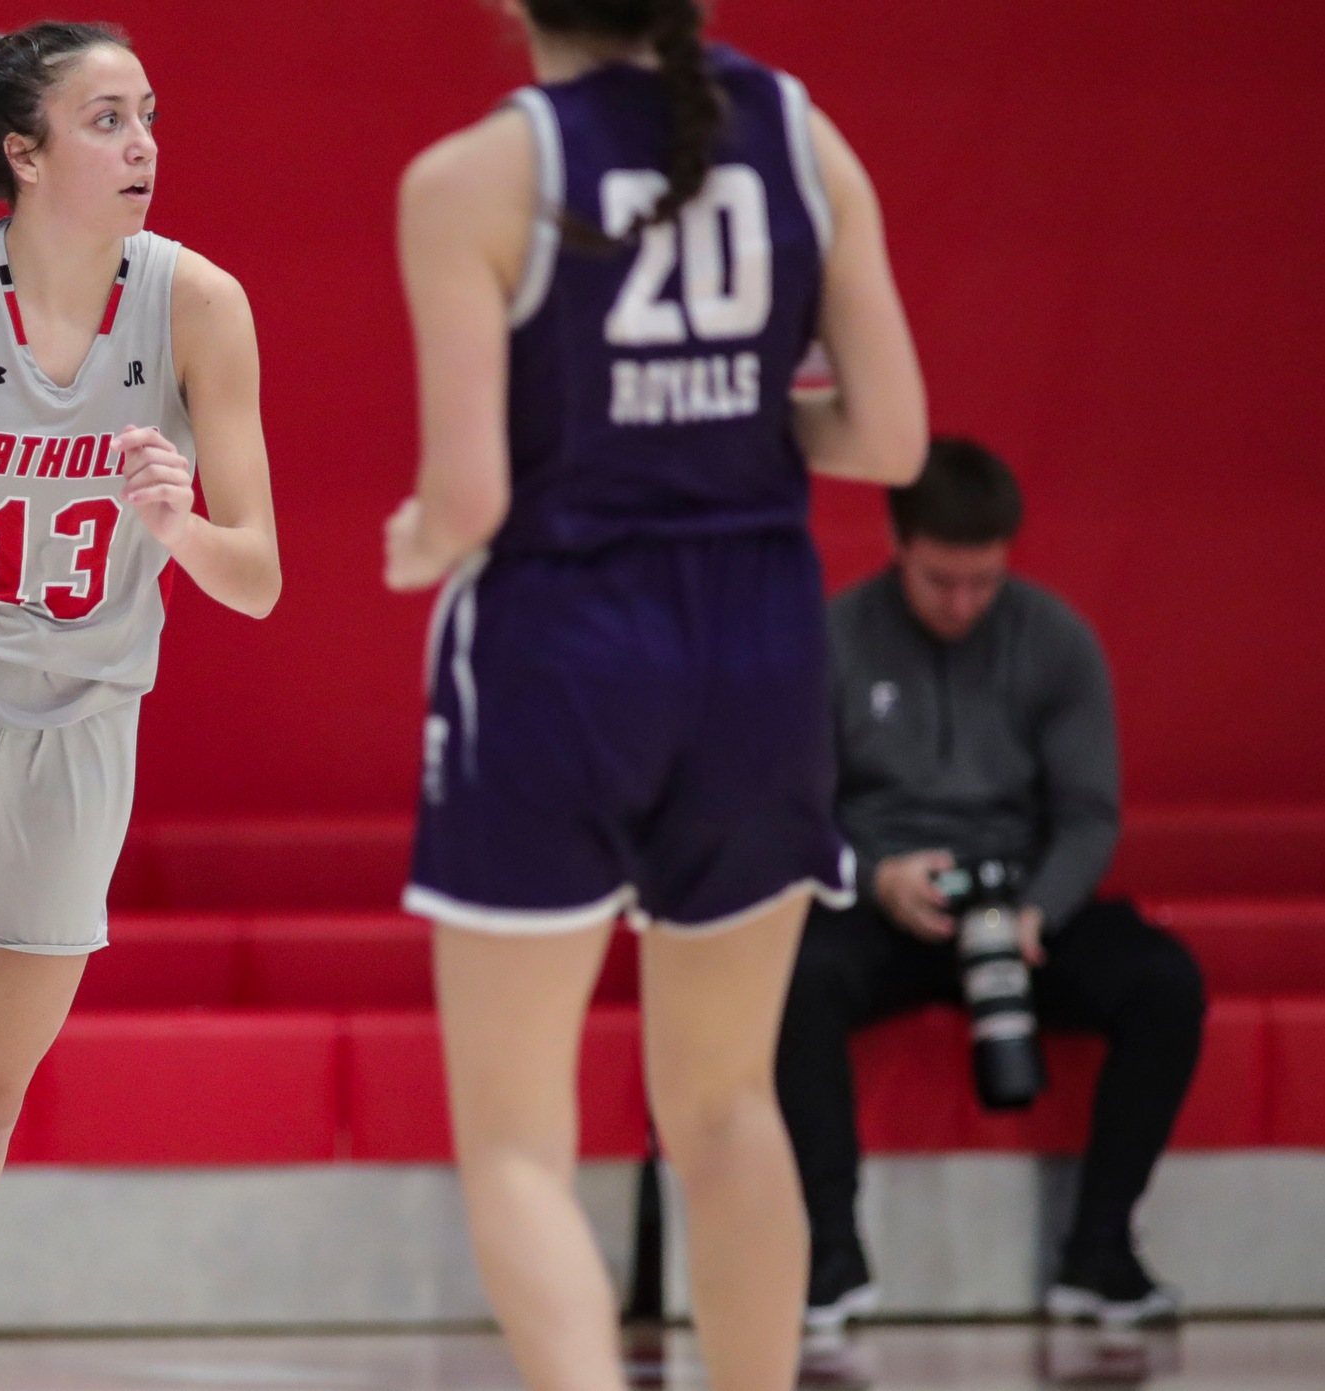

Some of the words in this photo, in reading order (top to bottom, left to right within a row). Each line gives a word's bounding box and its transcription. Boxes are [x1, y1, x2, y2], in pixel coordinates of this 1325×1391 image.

[599, 163, 772, 345] 20
[123, 360, 145, 387] JR
[609, 352, 760, 425] ROYALS
